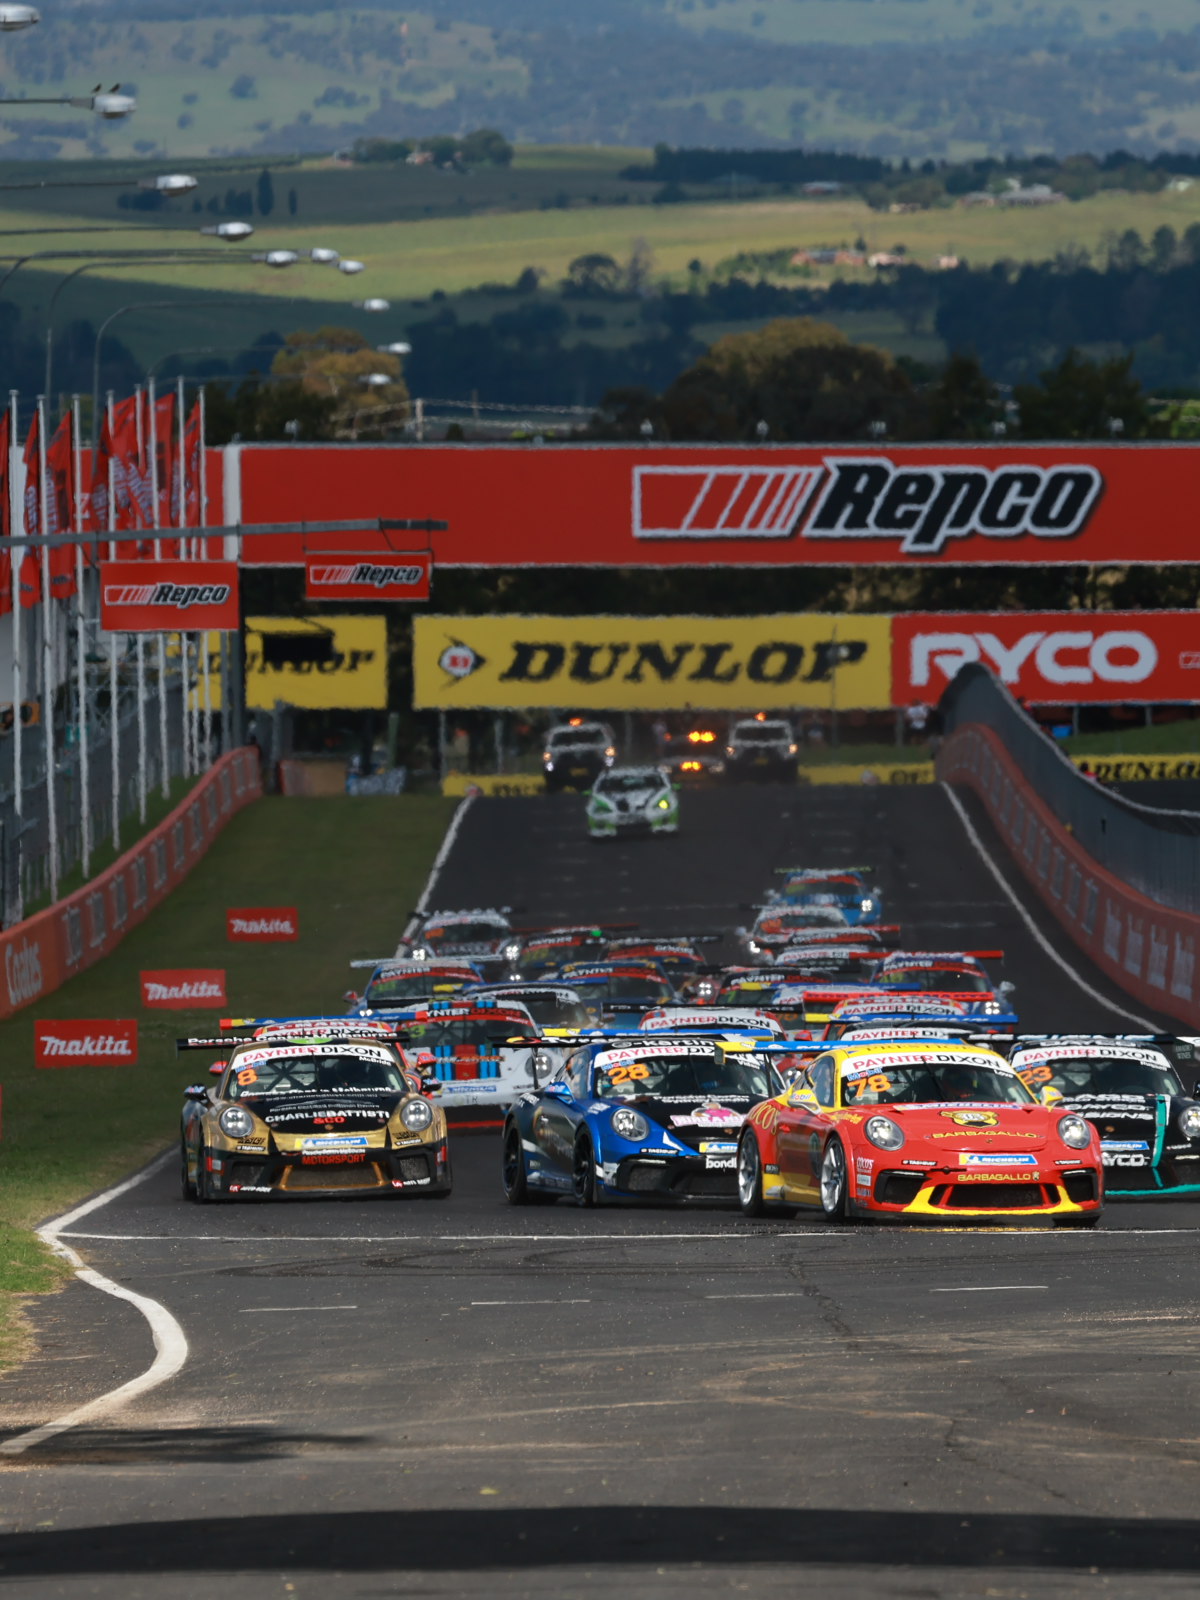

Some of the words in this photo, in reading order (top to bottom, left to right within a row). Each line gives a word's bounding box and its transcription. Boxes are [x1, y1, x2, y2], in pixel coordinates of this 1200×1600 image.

[803, 457, 1102, 552] Repco
[354, 563, 424, 588] Repco
[155, 582, 230, 609] Repco
[499, 640, 867, 684] DUNLOP
[910, 631, 1158, 687] RYCO
[427, 1008, 470, 1017] YNTER
[359, 1056, 392, 1067] McBride
[237, 1068, 259, 1086] 8
[608, 1063, 650, 1086] 28
[1020, 1066, 1053, 1086] 23
[847, 1075, 892, 1099] 78
[932, 1131, 1037, 1139] BARBAGALLO
[302, 1154, 366, 1166] MOTORSPORT
[957, 1172, 1031, 1182] BARBAGALLO
